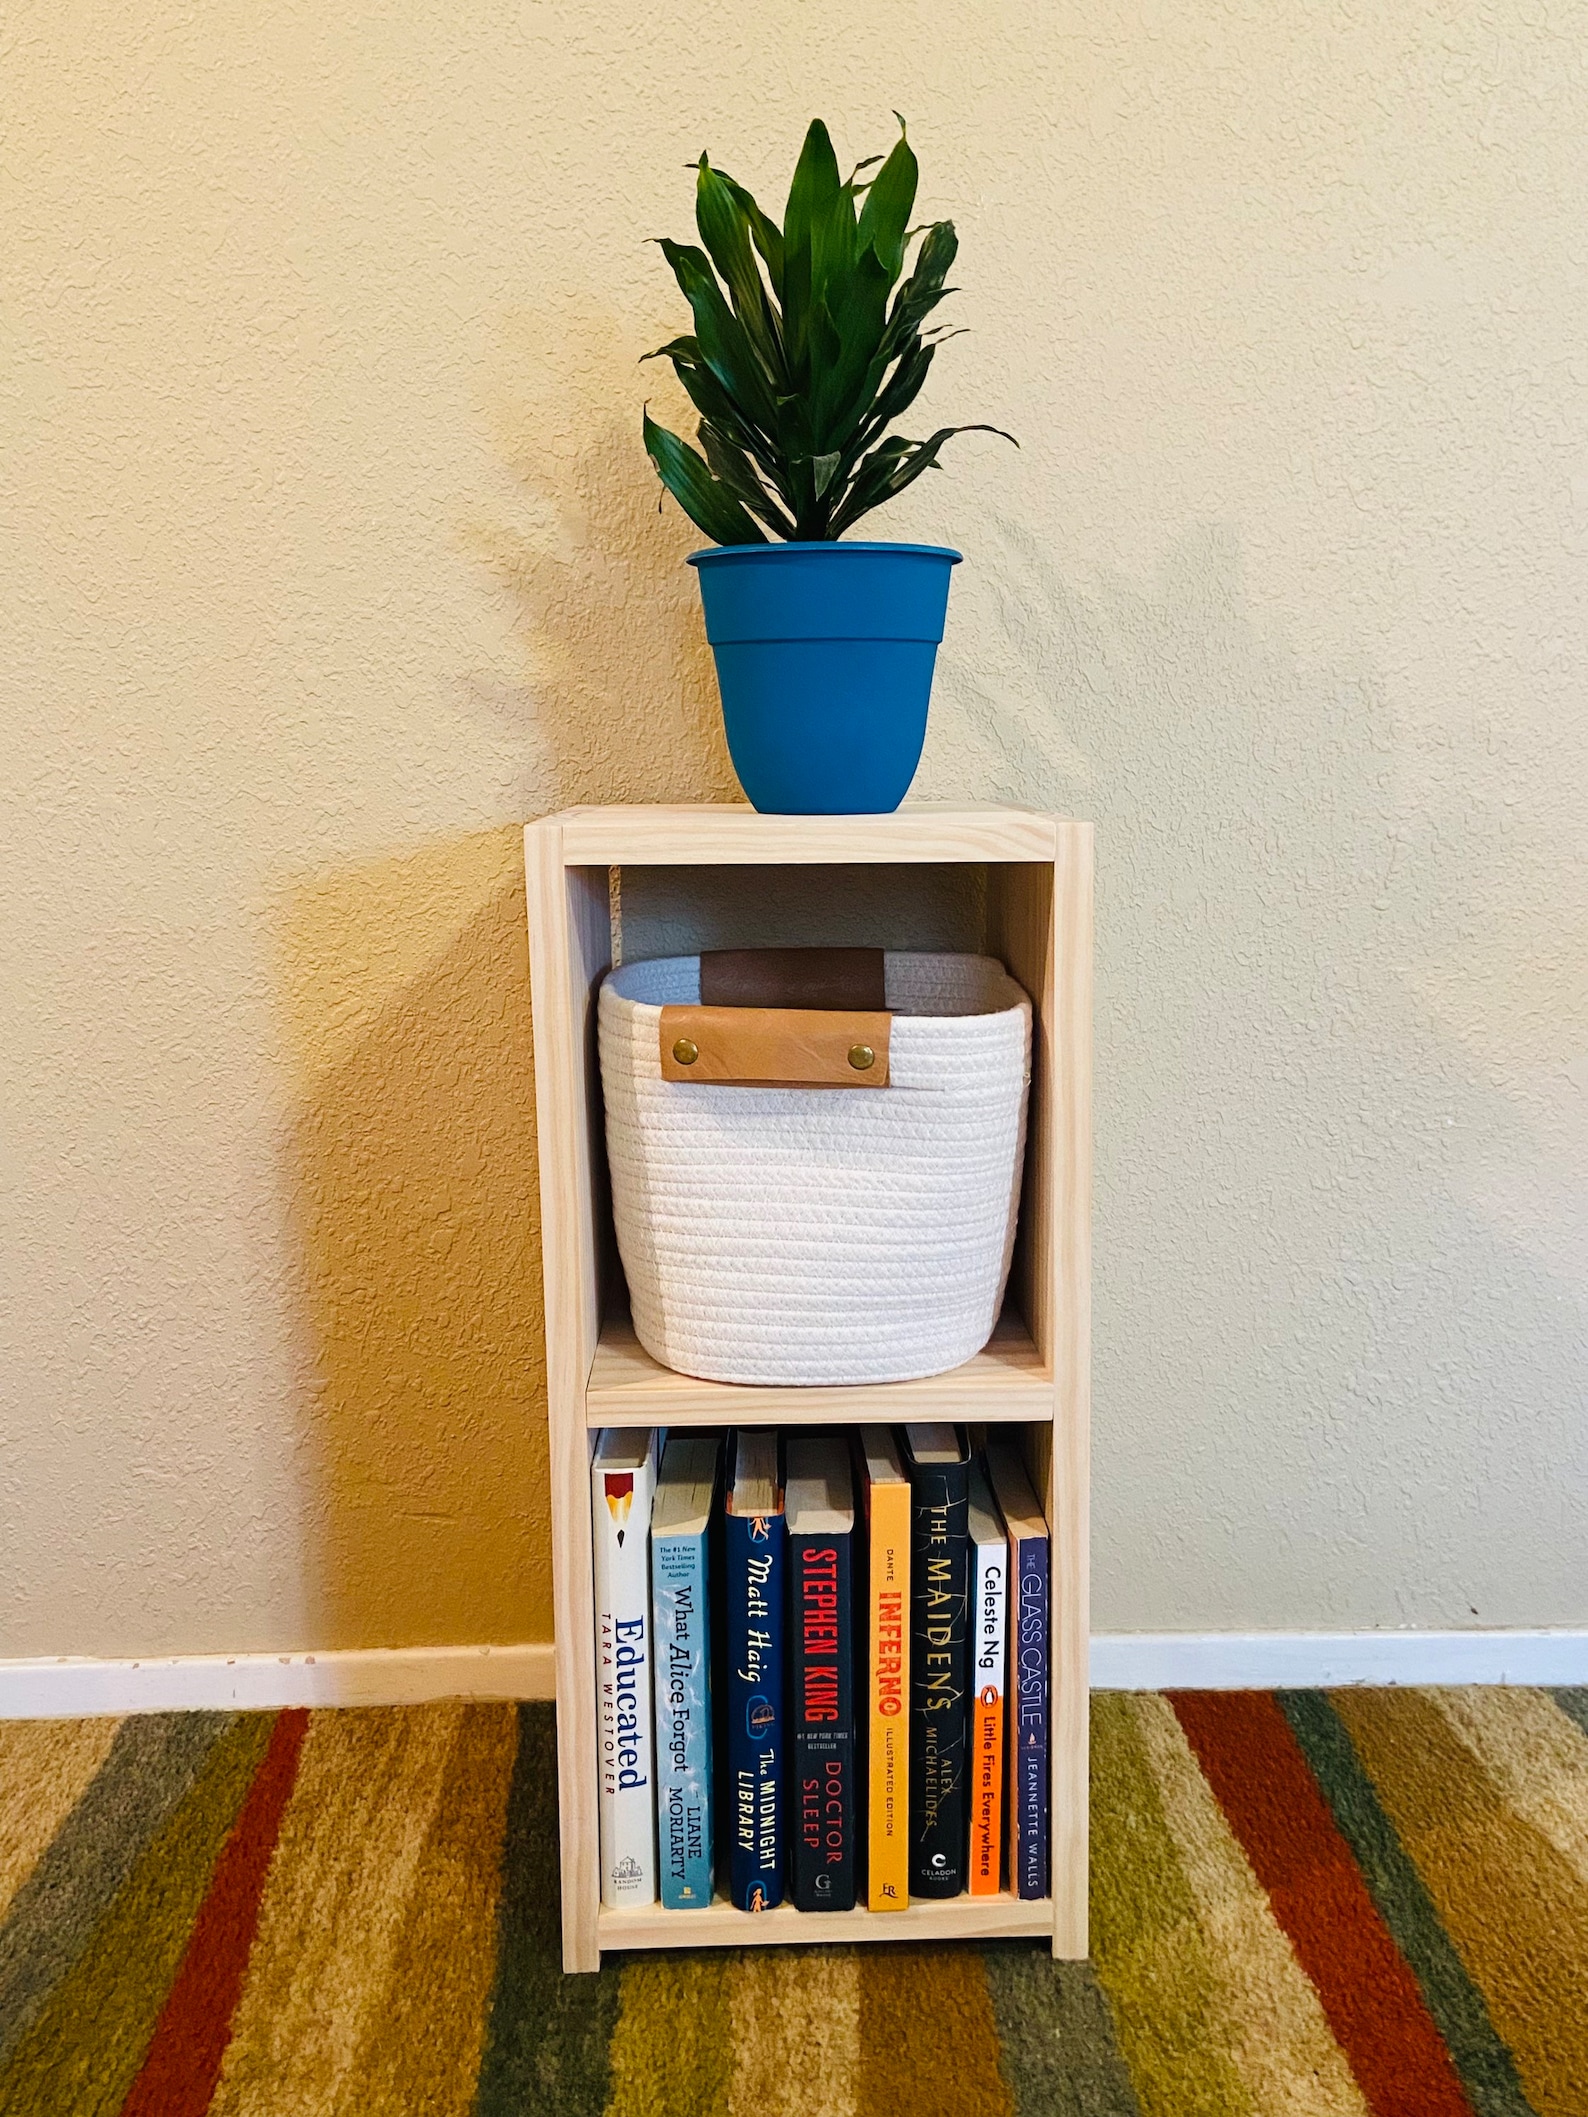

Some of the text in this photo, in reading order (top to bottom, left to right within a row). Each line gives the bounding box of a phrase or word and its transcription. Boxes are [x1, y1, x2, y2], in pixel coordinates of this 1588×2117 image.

[927, 1506, 951, 1710] THE MAIDENS
[1021, 1573, 1042, 1644] GLASS
[1026, 1554, 1036, 1569] THE
[737, 1554, 773, 1683] Matt Haig
[802, 1548, 839, 1723] STEPHEN KING
[876, 1591, 902, 1716] INFERNO
[978, 1566, 1002, 1669] Celeste Ng
[602, 1613, 615, 1794] TARA WESTOVER
[615, 1615, 647, 1791] Educated
[669, 1585, 694, 1772] What Alice Forgot
[1021, 1648, 1042, 1726] CASTLE
[738, 1770, 754, 1852] LIBRARY
[759, 1748, 776, 1870] The MIDNIGHT
[803, 1778, 820, 1848] SLEEP
[825, 1761, 843, 1865] DOCTOR
[886, 1727, 894, 1837] ILLUSTRATED EDITION
[925, 1726, 938, 1827] MICHAELIDES
[941, 1758, 952, 1794] ALEX
[980, 1716, 997, 1877] Little Fires Everywhere
[1027, 1757, 1039, 1836] JEANNETTE
[669, 1787, 685, 1880] MORIARTY
[687, 1806, 702, 1858] LIANE
[921, 1868, 957, 1876] CELADON
[1027, 1843, 1039, 1887] WALLS
